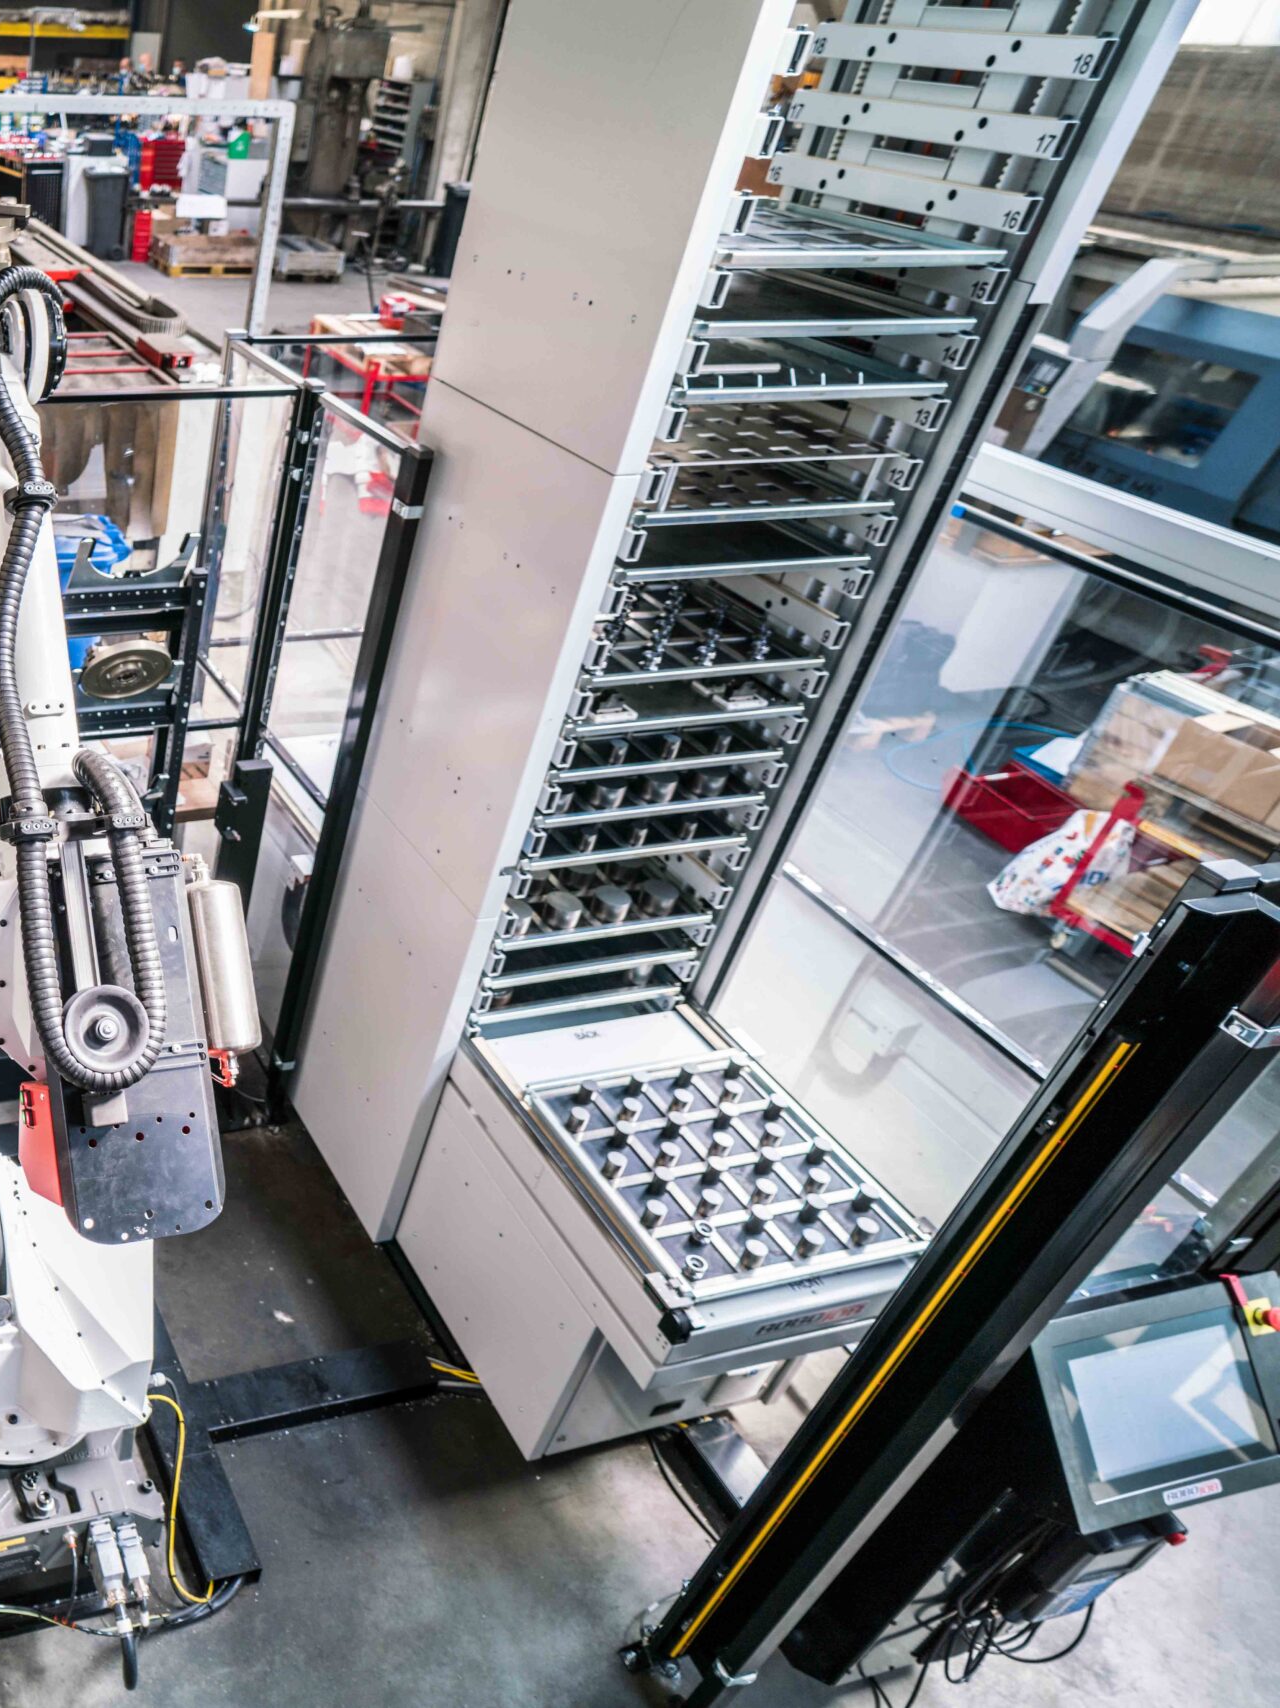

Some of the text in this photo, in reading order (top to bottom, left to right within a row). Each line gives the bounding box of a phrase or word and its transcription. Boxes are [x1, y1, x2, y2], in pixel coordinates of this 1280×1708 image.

[1072, 53, 1093, 75] 18
[790, 103, 805, 120] 17
[1035, 133, 1058, 154] 17
[1002, 210, 1021, 230] 16
[970, 280, 989, 300] 15
[942, 345, 960, 363] 14
[914, 408, 931, 426] 13
[888, 468, 905, 486] 12
[865, 523, 879, 537] 11
[841, 577, 857, 594] 10
[821, 629, 831, 644] 9
[800, 678, 810, 692] 8
[780, 724, 791, 737] 7
[761, 769, 771, 782] 6
[743, 812, 753, 825] 5
[709, 891, 717, 903] 3
[692, 928, 700, 940] 2
